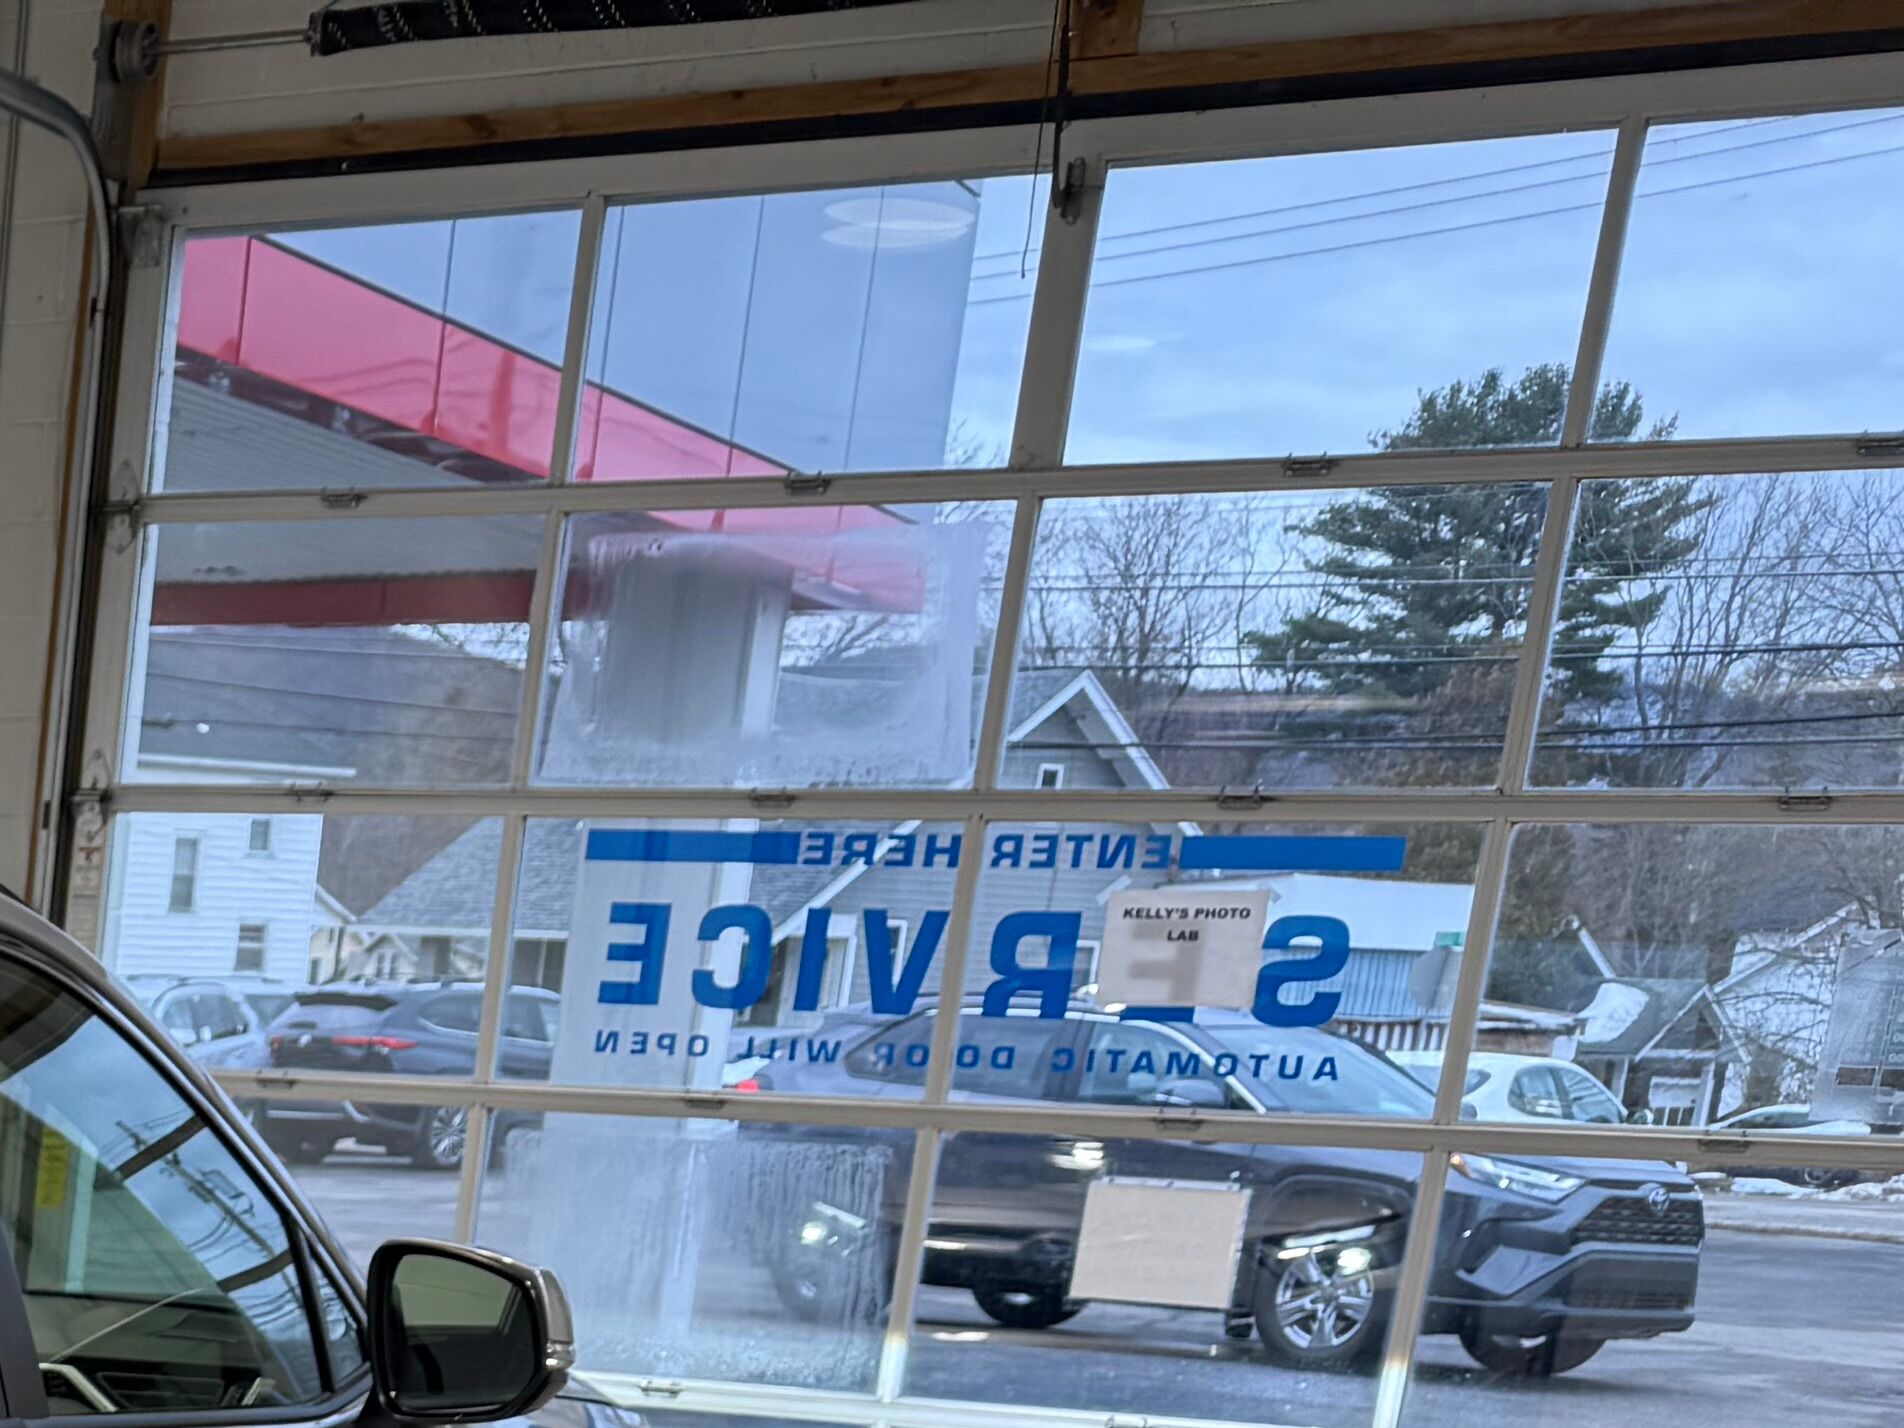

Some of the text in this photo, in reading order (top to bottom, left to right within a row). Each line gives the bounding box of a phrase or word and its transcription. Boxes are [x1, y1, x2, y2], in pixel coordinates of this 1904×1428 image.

[1123, 907, 1251, 919] KELLY'S PHOTO
[1167, 930, 1199, 941] LAB
